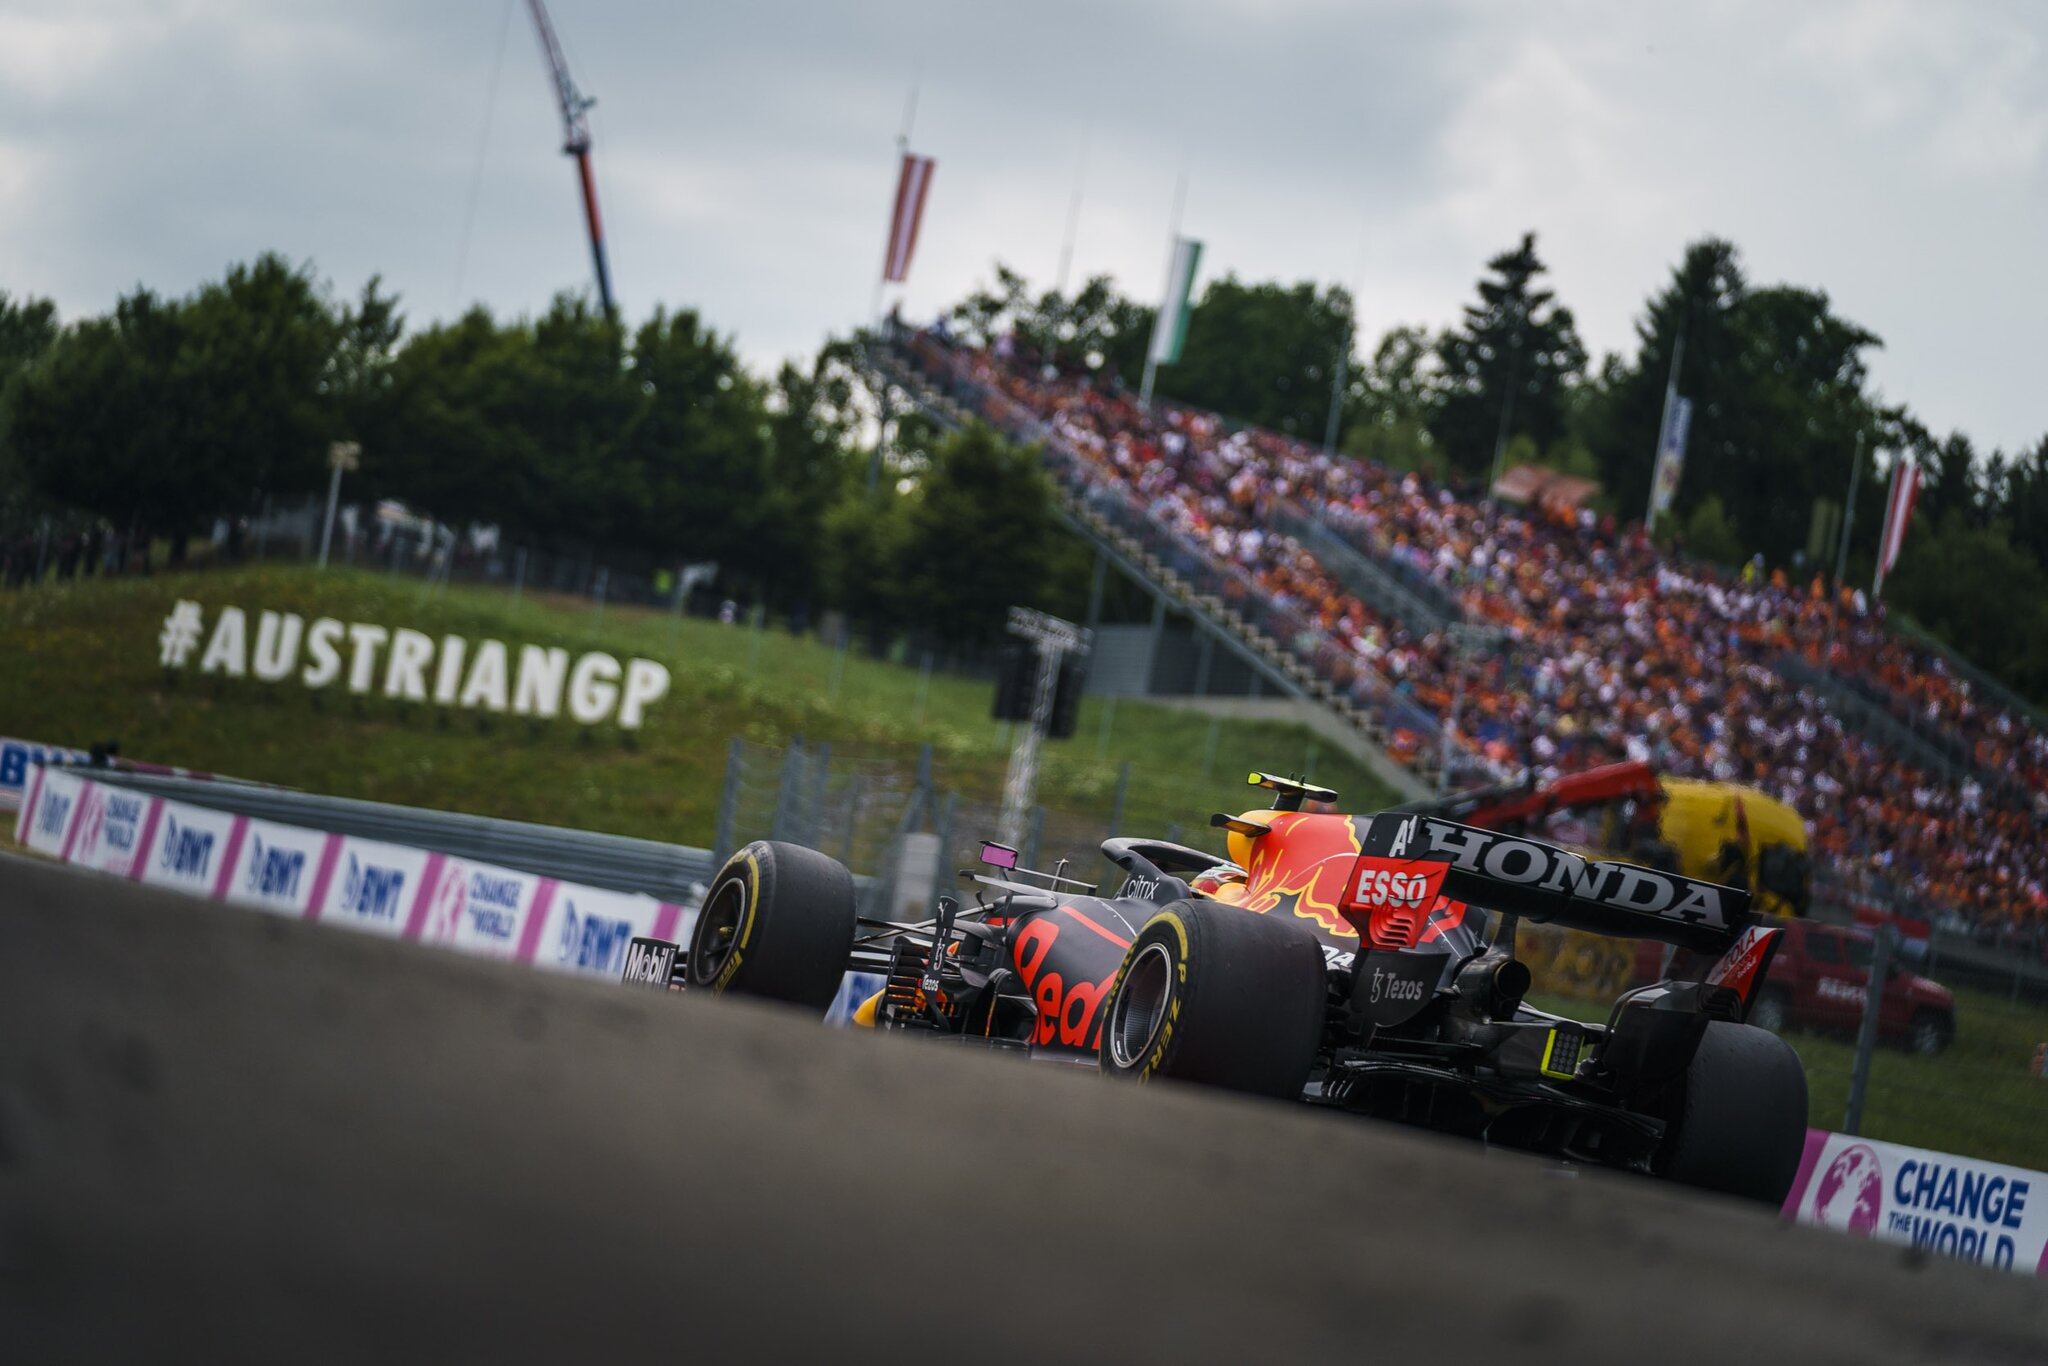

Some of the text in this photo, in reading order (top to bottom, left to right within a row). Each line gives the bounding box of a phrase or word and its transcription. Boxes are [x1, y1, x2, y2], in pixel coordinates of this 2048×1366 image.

[159, 600, 671, 729] #AUSTRIANGP
[1388, 814, 1418, 857] A1
[1127, 874, 1160, 900] citrix
[1424, 820, 1730, 930] HONDA
[624, 942, 669, 984] Mobil
[922, 974, 940, 992] Tezos
[1384, 972, 1425, 1001] Tezos
[1894, 1158, 2031, 1230] CHANGE
[1888, 1210, 1913, 1233] THE
